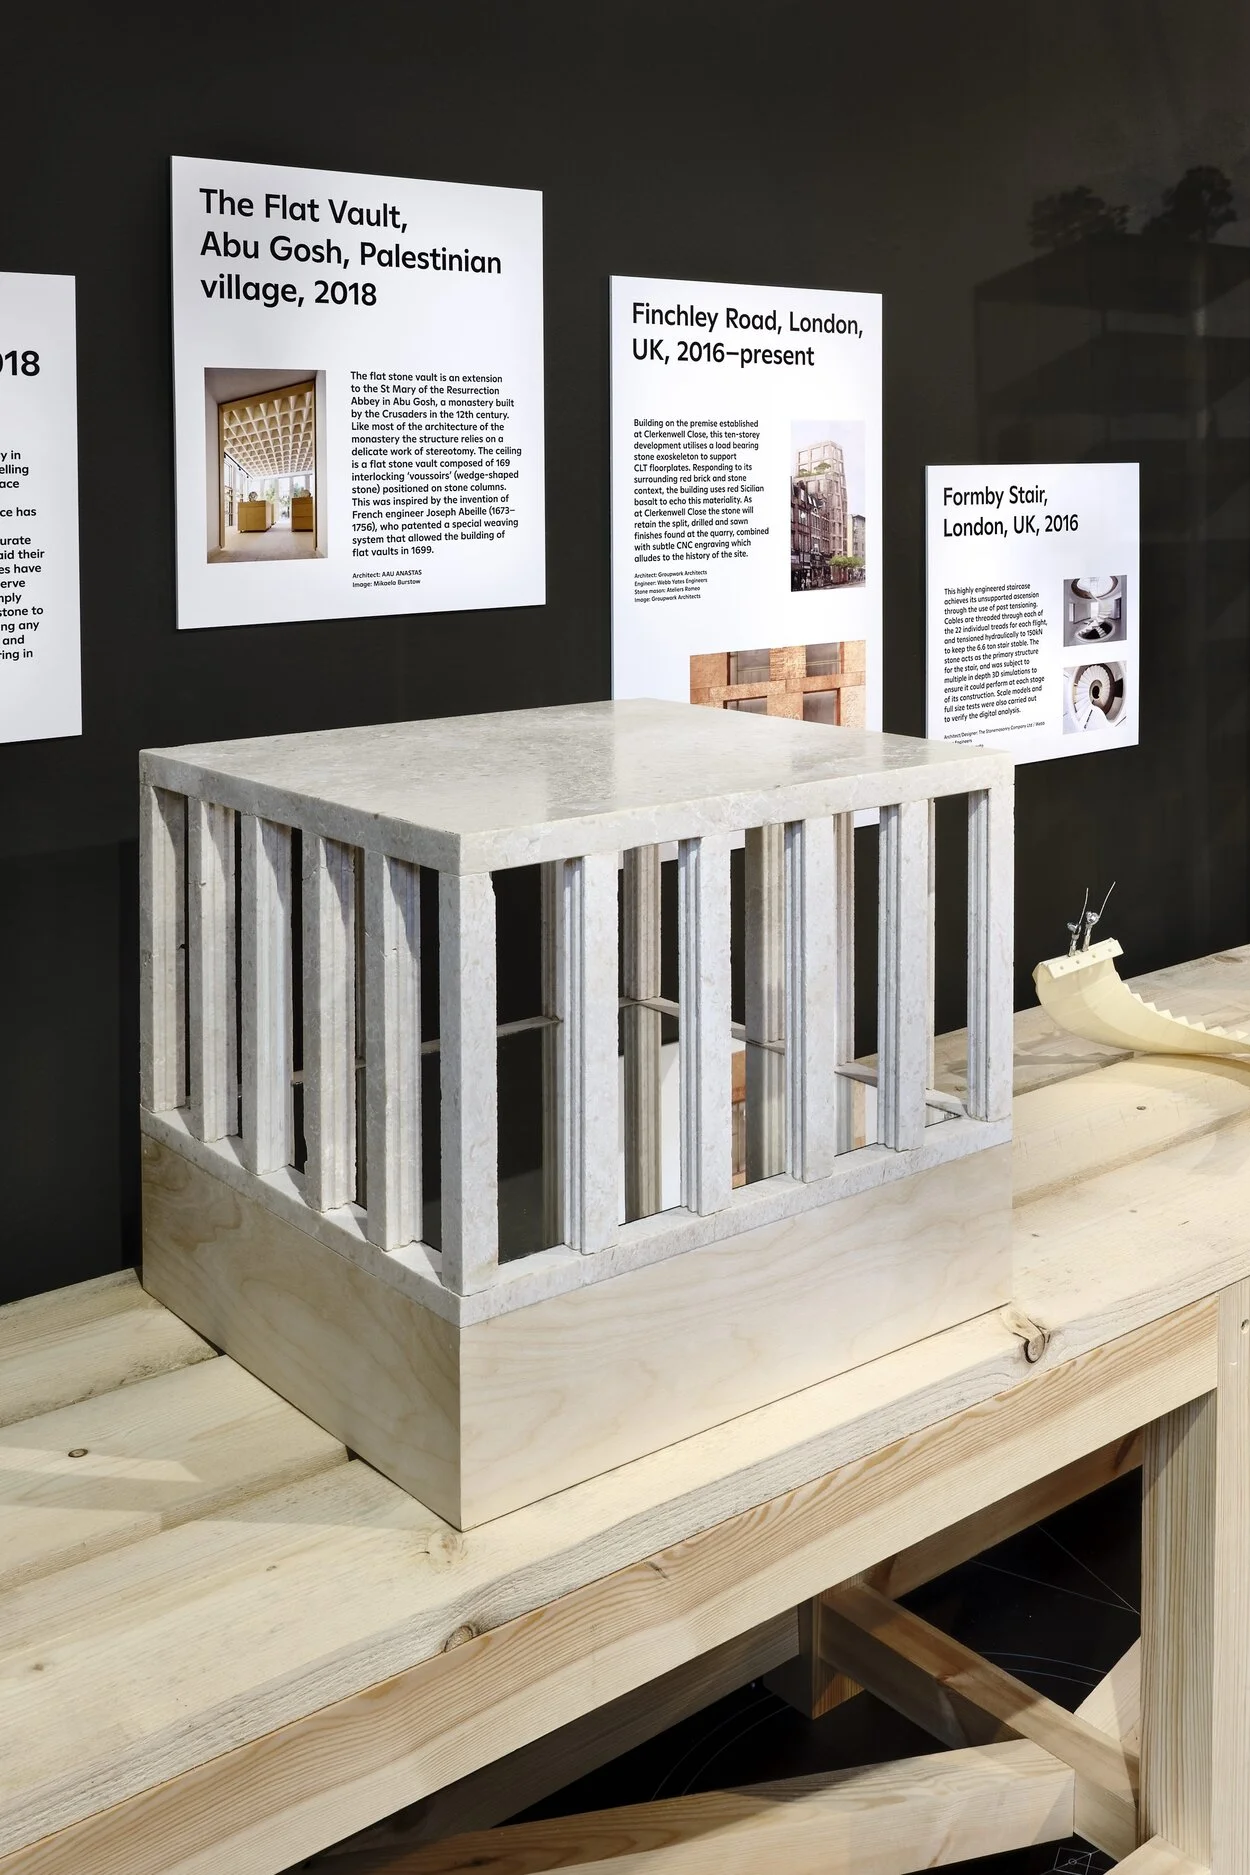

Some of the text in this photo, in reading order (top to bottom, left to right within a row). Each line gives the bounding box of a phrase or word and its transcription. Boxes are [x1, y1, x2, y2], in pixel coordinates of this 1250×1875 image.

[199, 187, 407, 233] The Flat Vault,
[199, 230, 501, 274] Abu Gosh, Palestinian
[200, 272, 376, 308] village, 2018
[632, 302, 863, 339] Finchley Road, London,
[632, 338, 814, 368] UK, 2016–present
[350, 370, 367, 380] The
[369, 371, 386, 380] flat
[388, 372, 413, 381] stone
[414, 372, 438, 381] vault
[439, 372, 446, 382] is
[461, 374, 502, 382] extension
[350, 383, 499, 395] to the St Mary of the Resurrection
[350, 396, 380, 407] Abbey
[382, 396, 390, 405] in
[392, 396, 410, 406] Abu
[412, 397, 438, 407] Gosh,
[448, 398, 494, 408] monastery
[495, 398, 514, 407] built
[350, 408, 509, 420] by the Crusaders in the 12th century.
[633, 418, 663, 428] Building
[676, 418, 688, 427] the
[689, 419, 718, 428] premise
[719, 419, 758, 427] established
[643, 429, 685, 438] Clerkenwell
[686, 430, 708, 439] Close,
[709, 430, 723, 438] this
[724, 431, 760, 439] ten-storey
[633, 441, 681, 450] development
[682, 441, 707, 449] utilises
[715, 441, 731, 449] load
[732, 441, 758, 450] bearing
[11, 450, 21, 460] in
[943, 484, 1047, 509] Formby Stair,
[16, 507, 36, 516] has
[943, 513, 1078, 538] London, UK, 2016
[18, 549, 45, 559] their
[352, 545, 434, 557] flat vaults in 1699.
[14, 564, 42, 573] have
[956, 586, 974, 595] highly
[974, 583, 1005, 594] engineered
[977, 592, 1012, 603] unsupported
[1012, 591, 1039, 599] ascension
[32, 606, 44, 615] to
[18, 622, 39, 631] any
[2, 635, 24, 645] and
[23, 649, 33, 658] in
[951, 713, 968, 721] verify
[978, 709, 997, 719] digital
[997, 706, 1021, 715] analysis.
